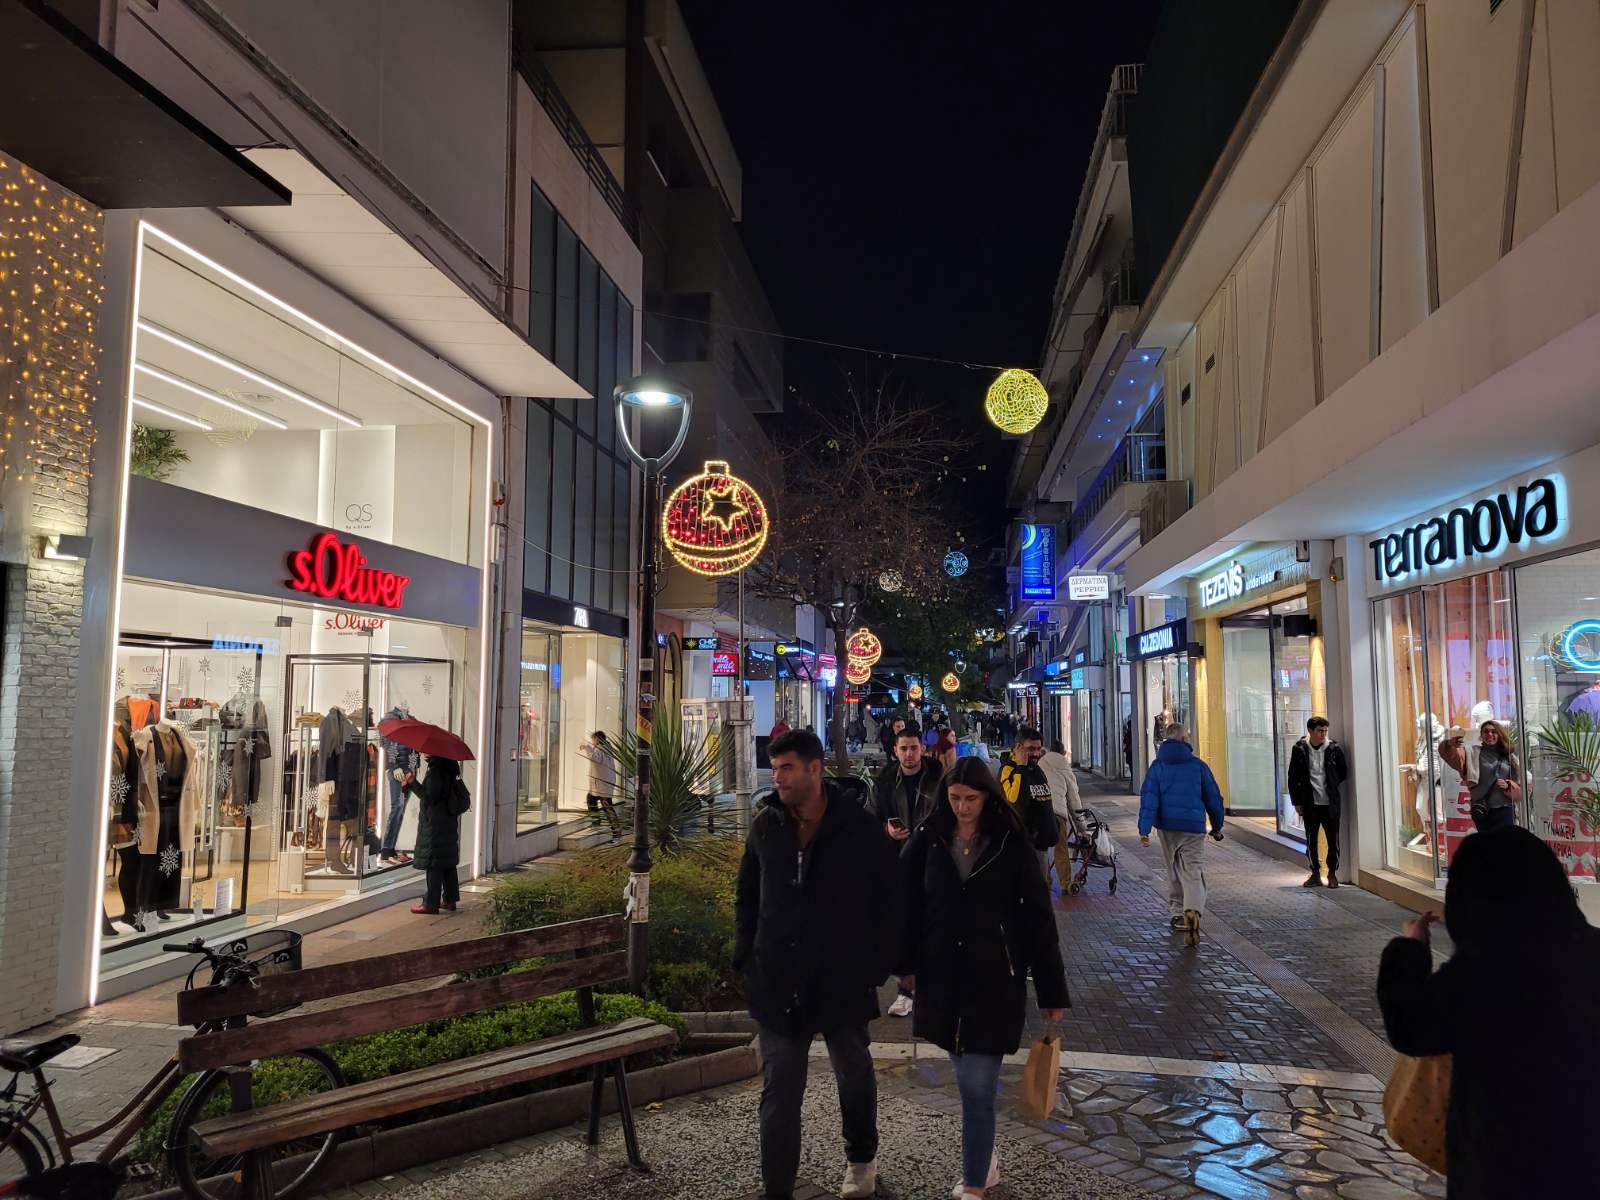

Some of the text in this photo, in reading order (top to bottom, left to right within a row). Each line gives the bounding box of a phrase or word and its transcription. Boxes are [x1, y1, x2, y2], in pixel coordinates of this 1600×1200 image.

[345, 503, 373, 523] QS
[285, 531, 410, 608] s.Oliver
[1199, 560, 1245, 608] TEZENIS
[1140, 627, 1174, 654] CALZEDONIA
